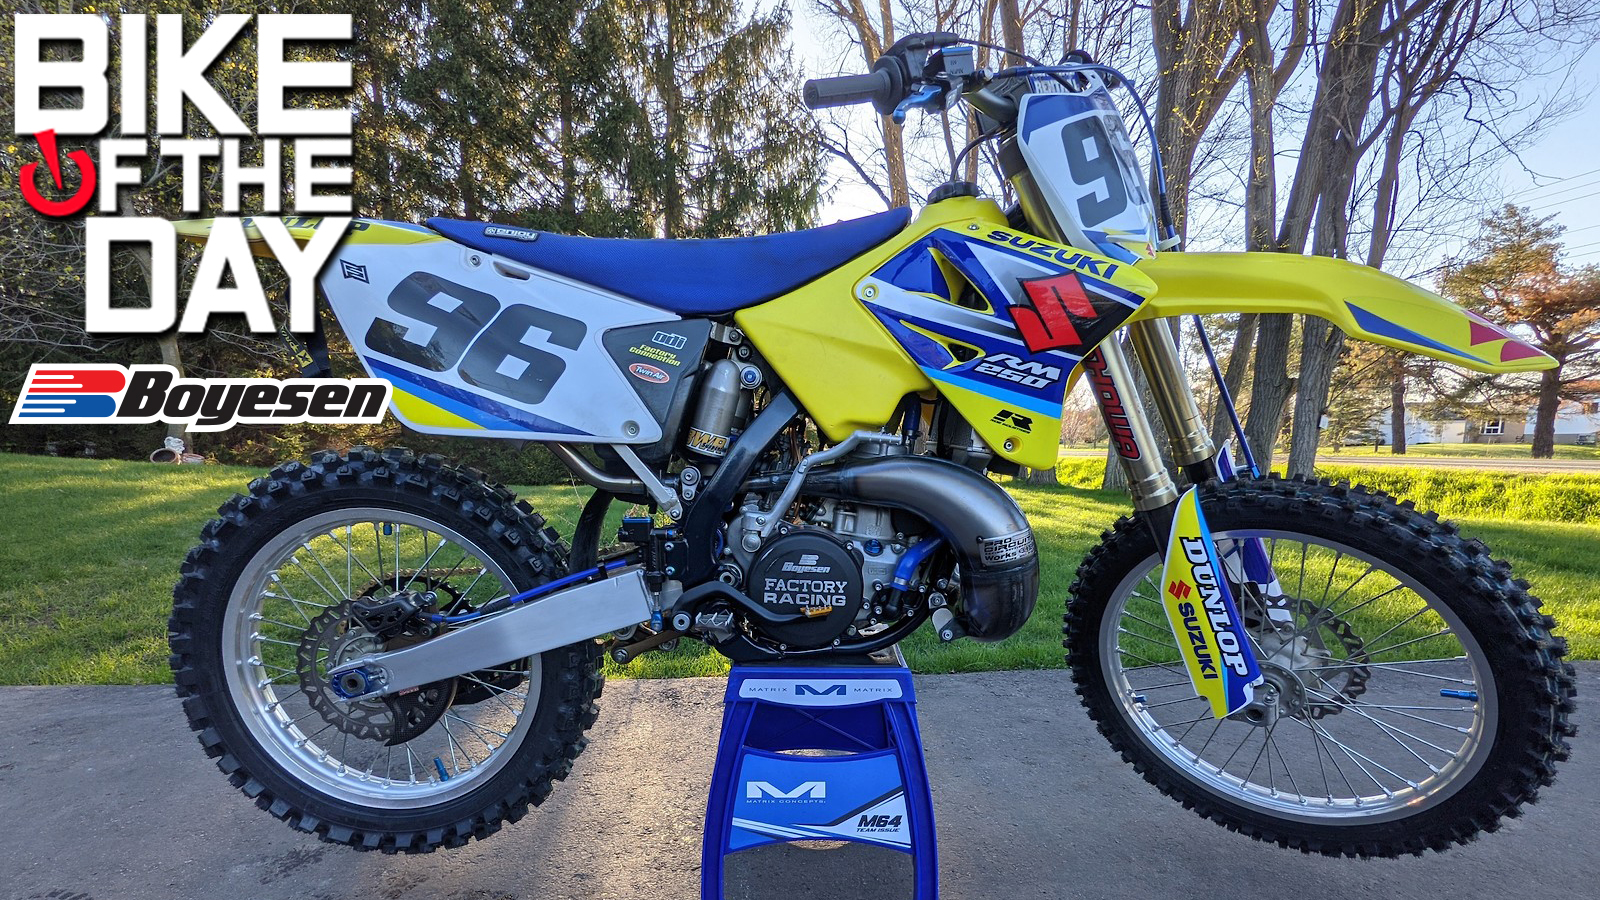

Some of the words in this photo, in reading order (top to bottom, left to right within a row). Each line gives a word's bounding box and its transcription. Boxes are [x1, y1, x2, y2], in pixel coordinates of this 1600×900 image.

[1033, 78, 1081, 94] RENTL
[987, 231, 1119, 279] SUZUKI
[364, 270, 588, 405] 96
[635, 365, 653, 376] Twin
[653, 372, 666, 380] Air
[983, 353, 1061, 380] RM
[974, 362, 1052, 389] 250
[985, 551, 1017, 561] Works
[782, 562, 831, 574] Boyesen
[764, 578, 848, 594] FACTORY
[763, 592, 847, 606] RACING
[1179, 536, 1249, 677] DUNLOP
[1178, 602, 1219, 680] SUZUKI
[857, 814, 903, 828] M64
